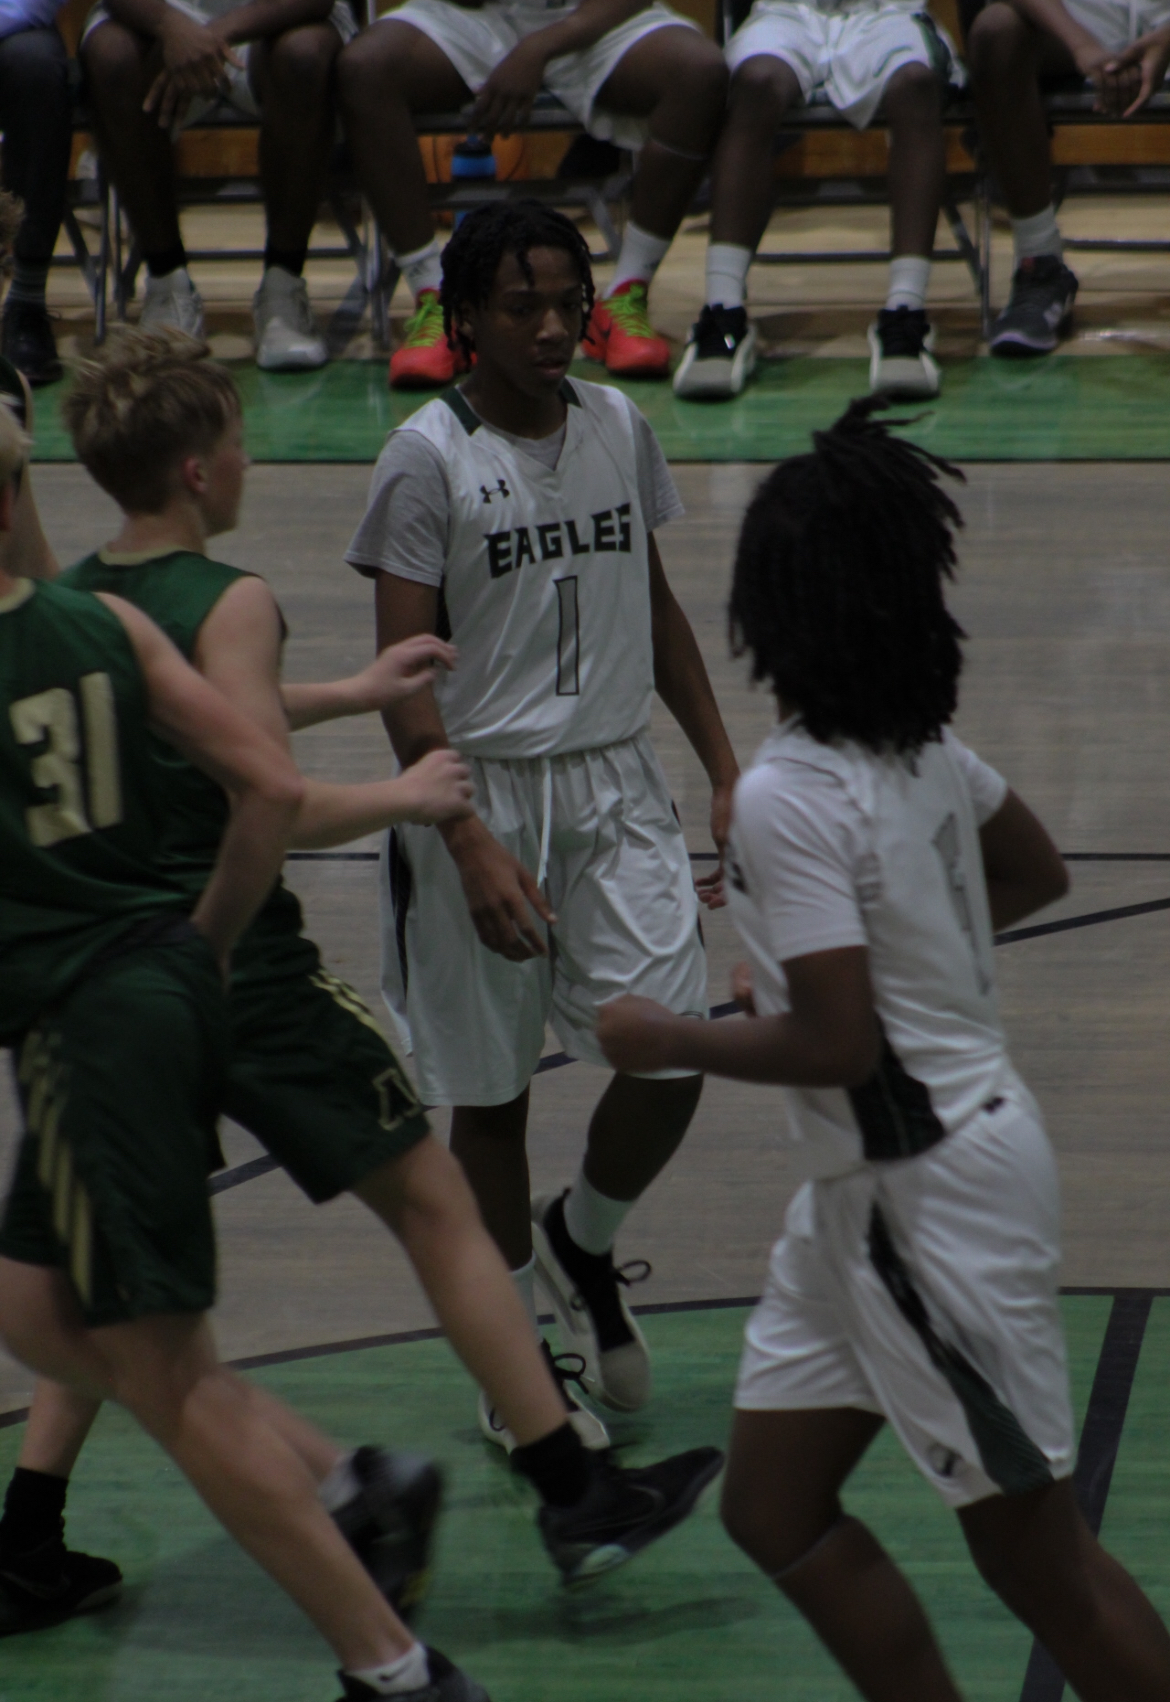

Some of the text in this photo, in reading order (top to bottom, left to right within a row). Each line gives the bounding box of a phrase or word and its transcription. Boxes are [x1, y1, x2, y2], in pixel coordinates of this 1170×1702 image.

[483, 502, 632, 579] EAGLES
[553, 575, 580, 696] 1
[9, 669, 124, 848] 31
